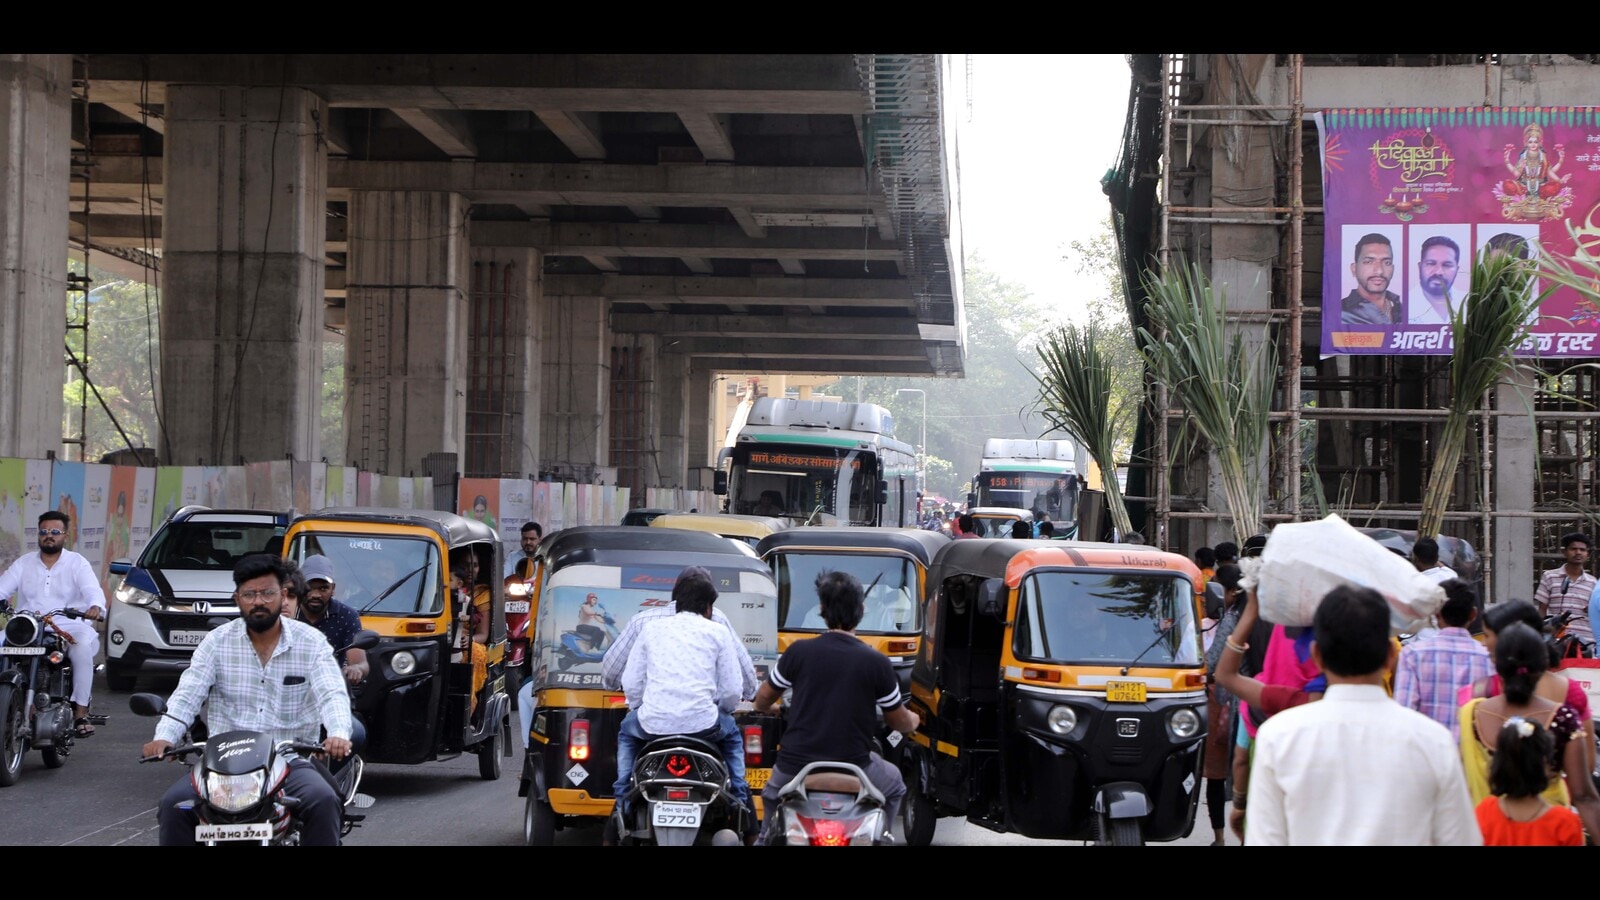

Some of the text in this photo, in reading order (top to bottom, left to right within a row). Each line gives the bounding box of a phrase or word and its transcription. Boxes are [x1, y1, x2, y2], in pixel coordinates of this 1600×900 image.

[1390, 326, 1449, 350] आदर्श
[1556, 332, 1598, 353] ट्रस्ट
[990, 477, 1007, 487] 158
[557, 673, 605, 684] THE SH
[657, 815, 696, 825] 5770
